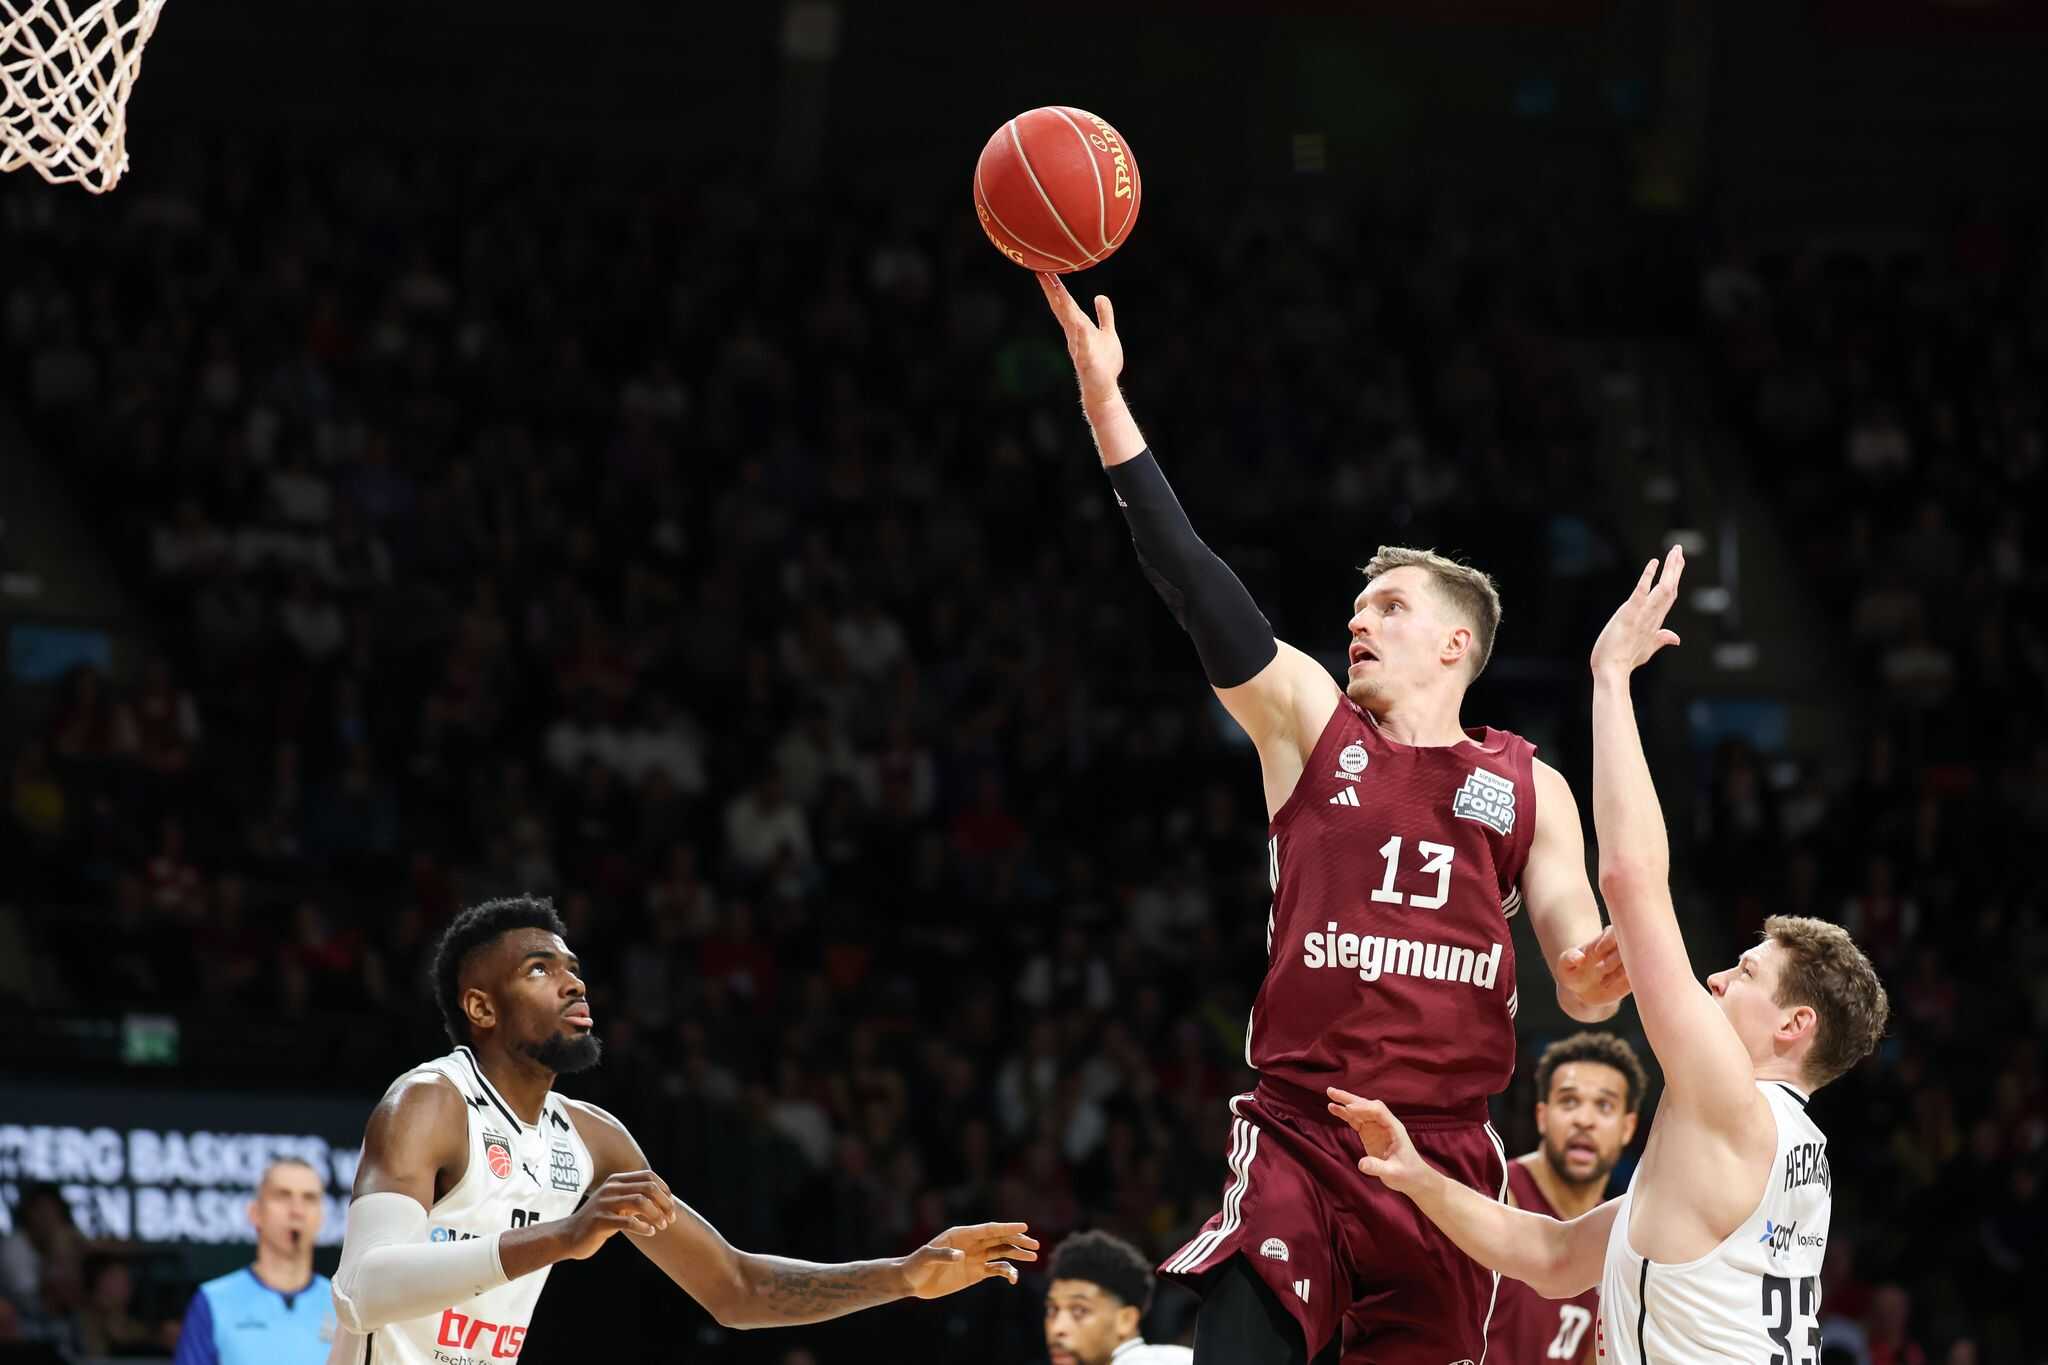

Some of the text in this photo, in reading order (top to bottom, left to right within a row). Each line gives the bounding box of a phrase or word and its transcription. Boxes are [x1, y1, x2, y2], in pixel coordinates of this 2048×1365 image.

[1458, 793, 1513, 826] FOUR
[1469, 780, 1513, 806] TOP
[1370, 835, 1455, 910] 13
[1303, 921, 1503, 990] siegmund
[551, 1151, 574, 1168] TOP
[551, 1165, 580, 1184] FOUR
[1762, 1273, 1821, 1365] 33
